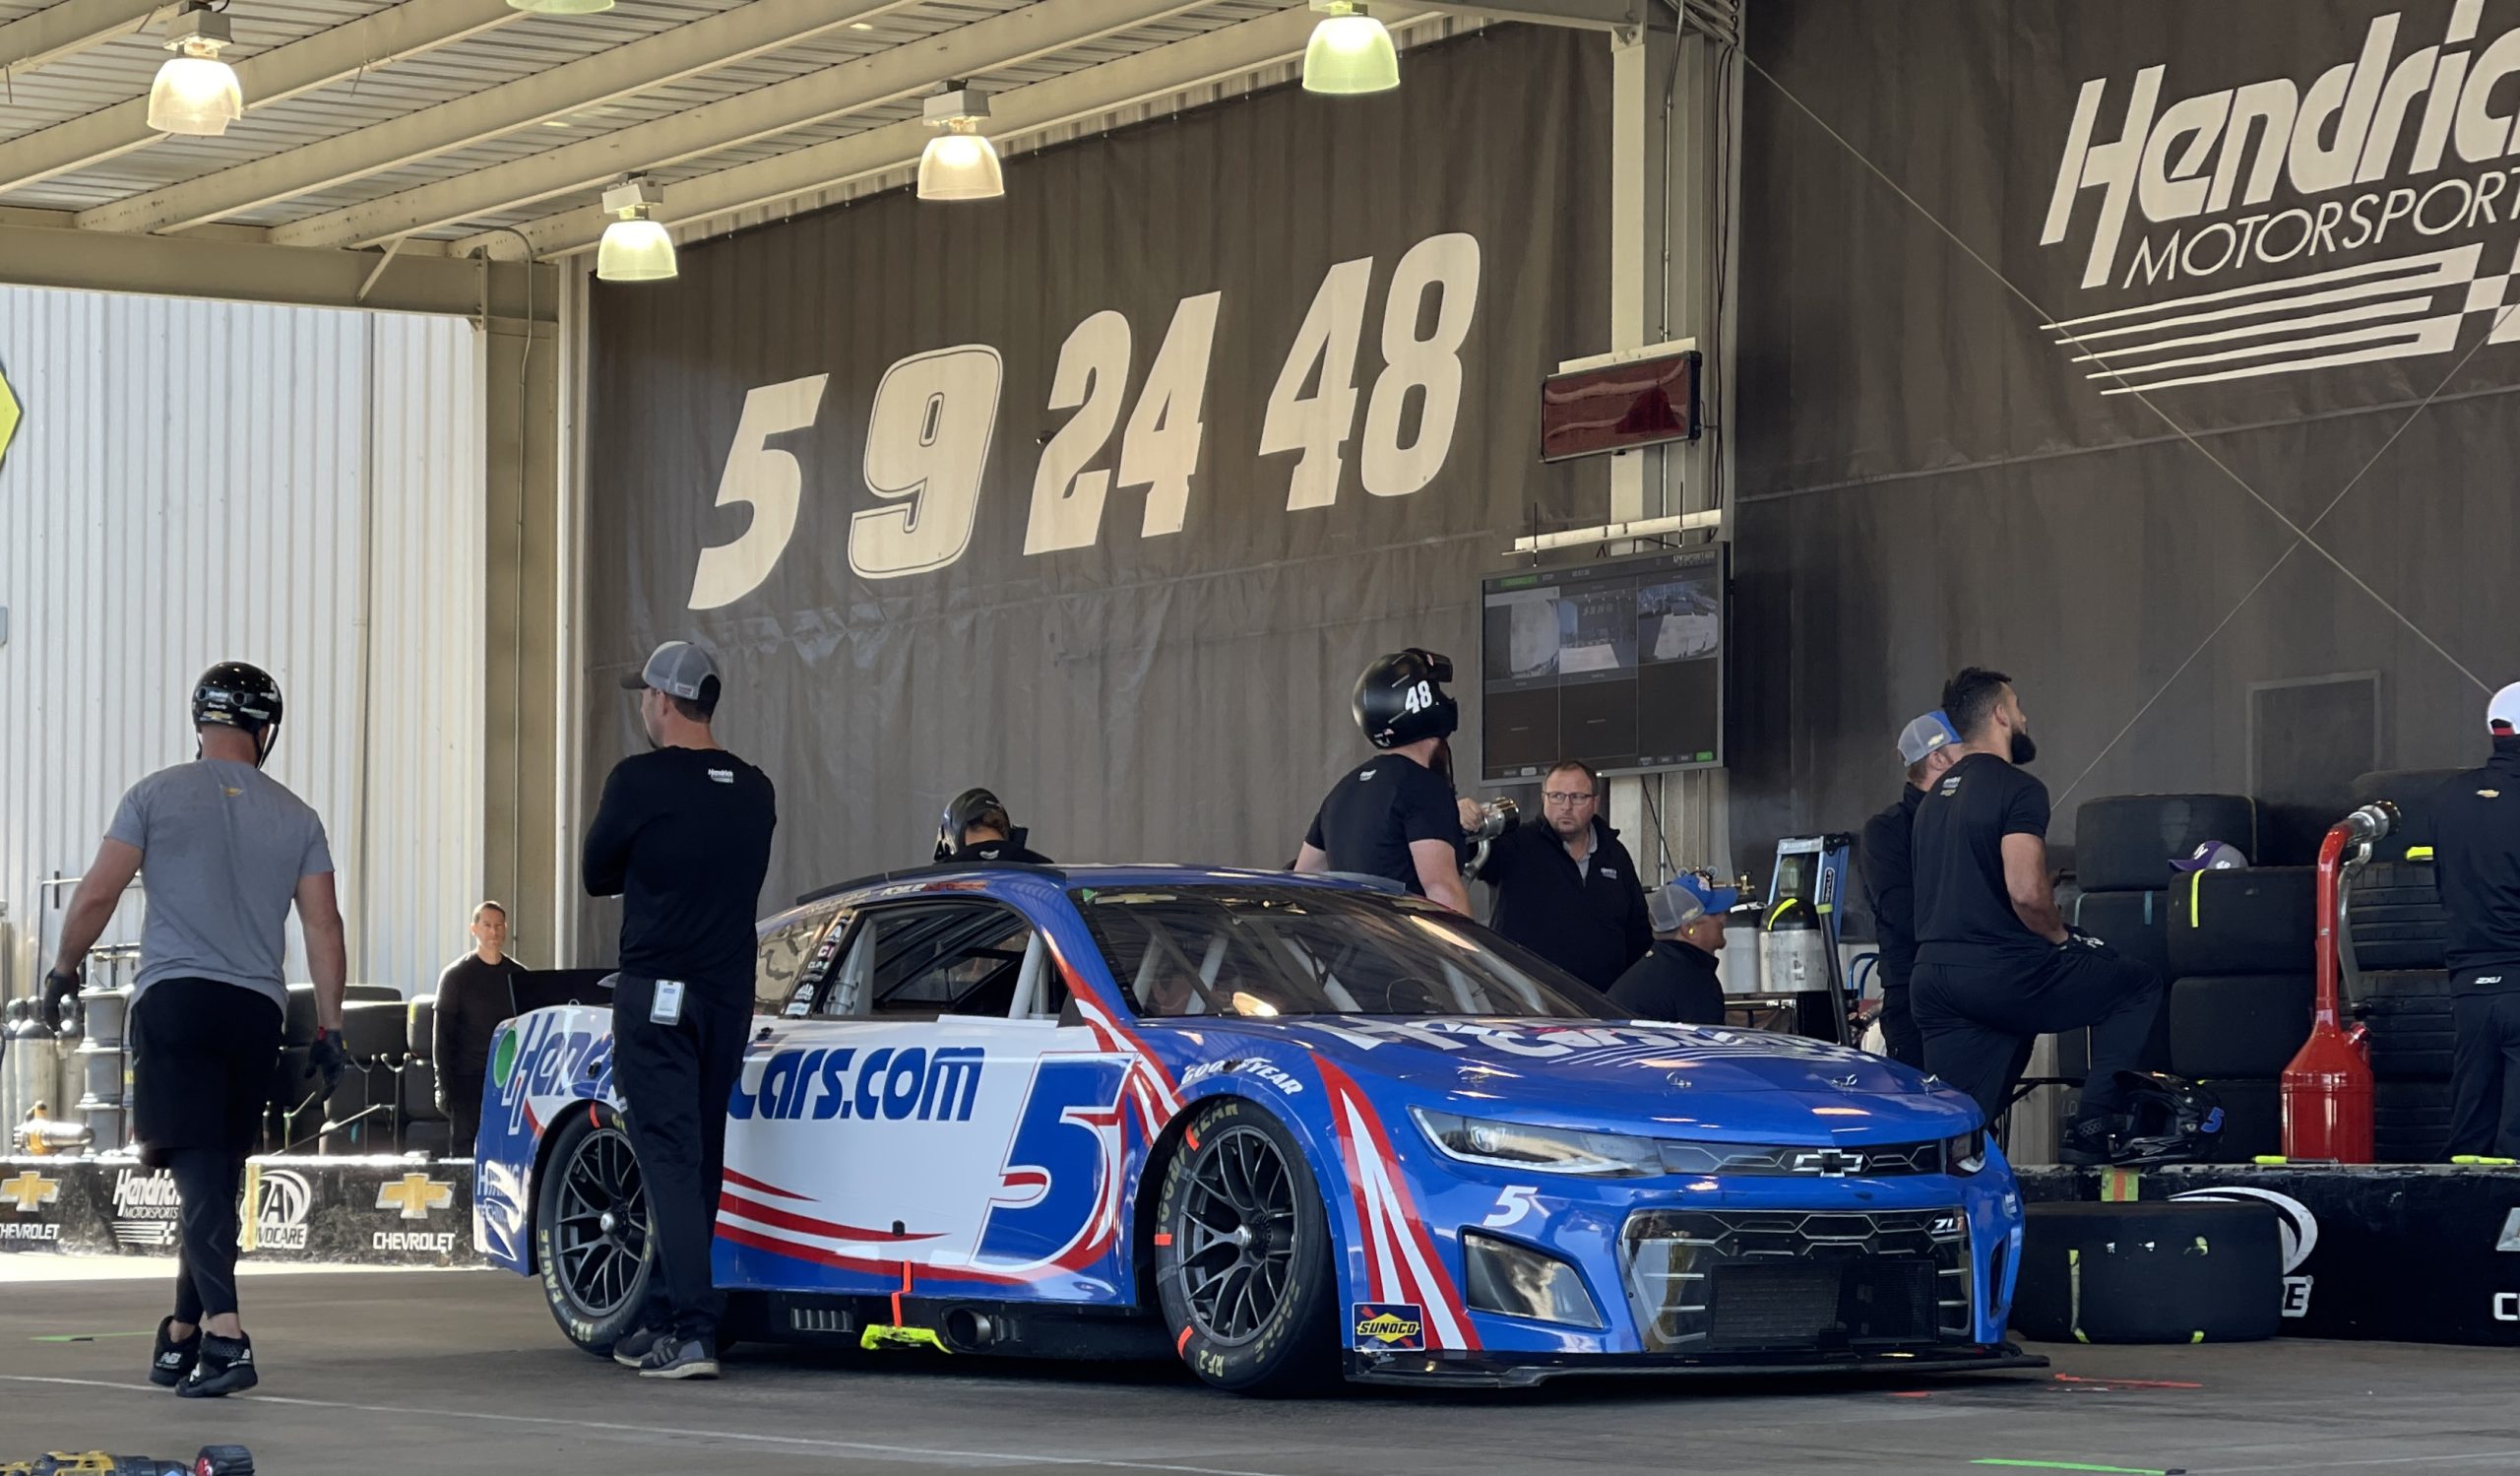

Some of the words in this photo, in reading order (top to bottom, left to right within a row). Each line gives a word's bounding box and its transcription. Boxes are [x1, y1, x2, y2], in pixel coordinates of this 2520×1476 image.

[2040, 0, 2520, 289] Hendric
[687, 373, 830, 610] 5
[848, 343, 1003, 579] 9
[1024, 290, 1222, 555] 24
[1259, 232, 1480, 512] 48
[1405, 680, 1432, 714] 48
[1180, 1057, 1304, 1096] GOOYEAR
[2200, 1106, 2225, 1133] 5
[969, 1051, 1140, 1273] 5
[1481, 1185, 1539, 1228] 5
[0, 1222, 60, 1240] HEVROLET
[373, 1232, 456, 1251] CHEVROLET
[1358, 1321, 1418, 1334] SUNOCO
